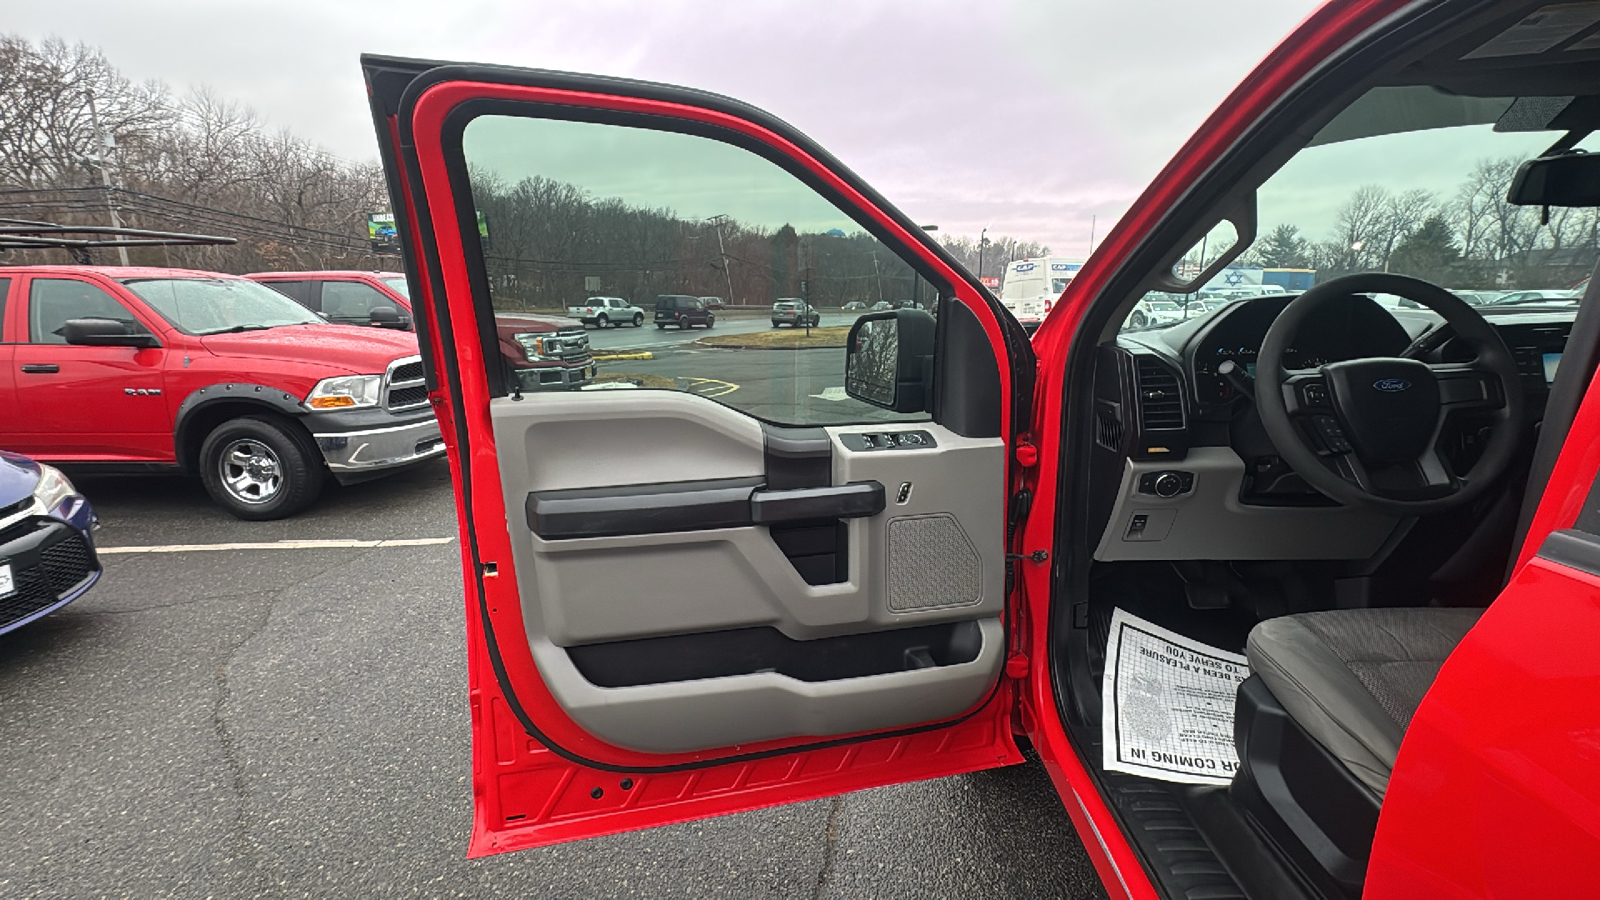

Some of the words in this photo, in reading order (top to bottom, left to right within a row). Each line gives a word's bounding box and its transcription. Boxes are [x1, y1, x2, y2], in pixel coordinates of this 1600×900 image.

[1381, 381, 1402, 389] Ford
[124, 388, 162, 396] RAM
[1166, 645, 1186, 660] YOU
[1140, 646, 1190, 671] PLEASURE
[1189, 653, 1222, 669] SERVE
[1193, 665, 1201, 673] A
[1225, 664, 1239, 673] TO
[1203, 669, 1231, 680] BEEN
[1131, 747, 1146, 759] IN
[1151, 751, 1216, 769] COMING
